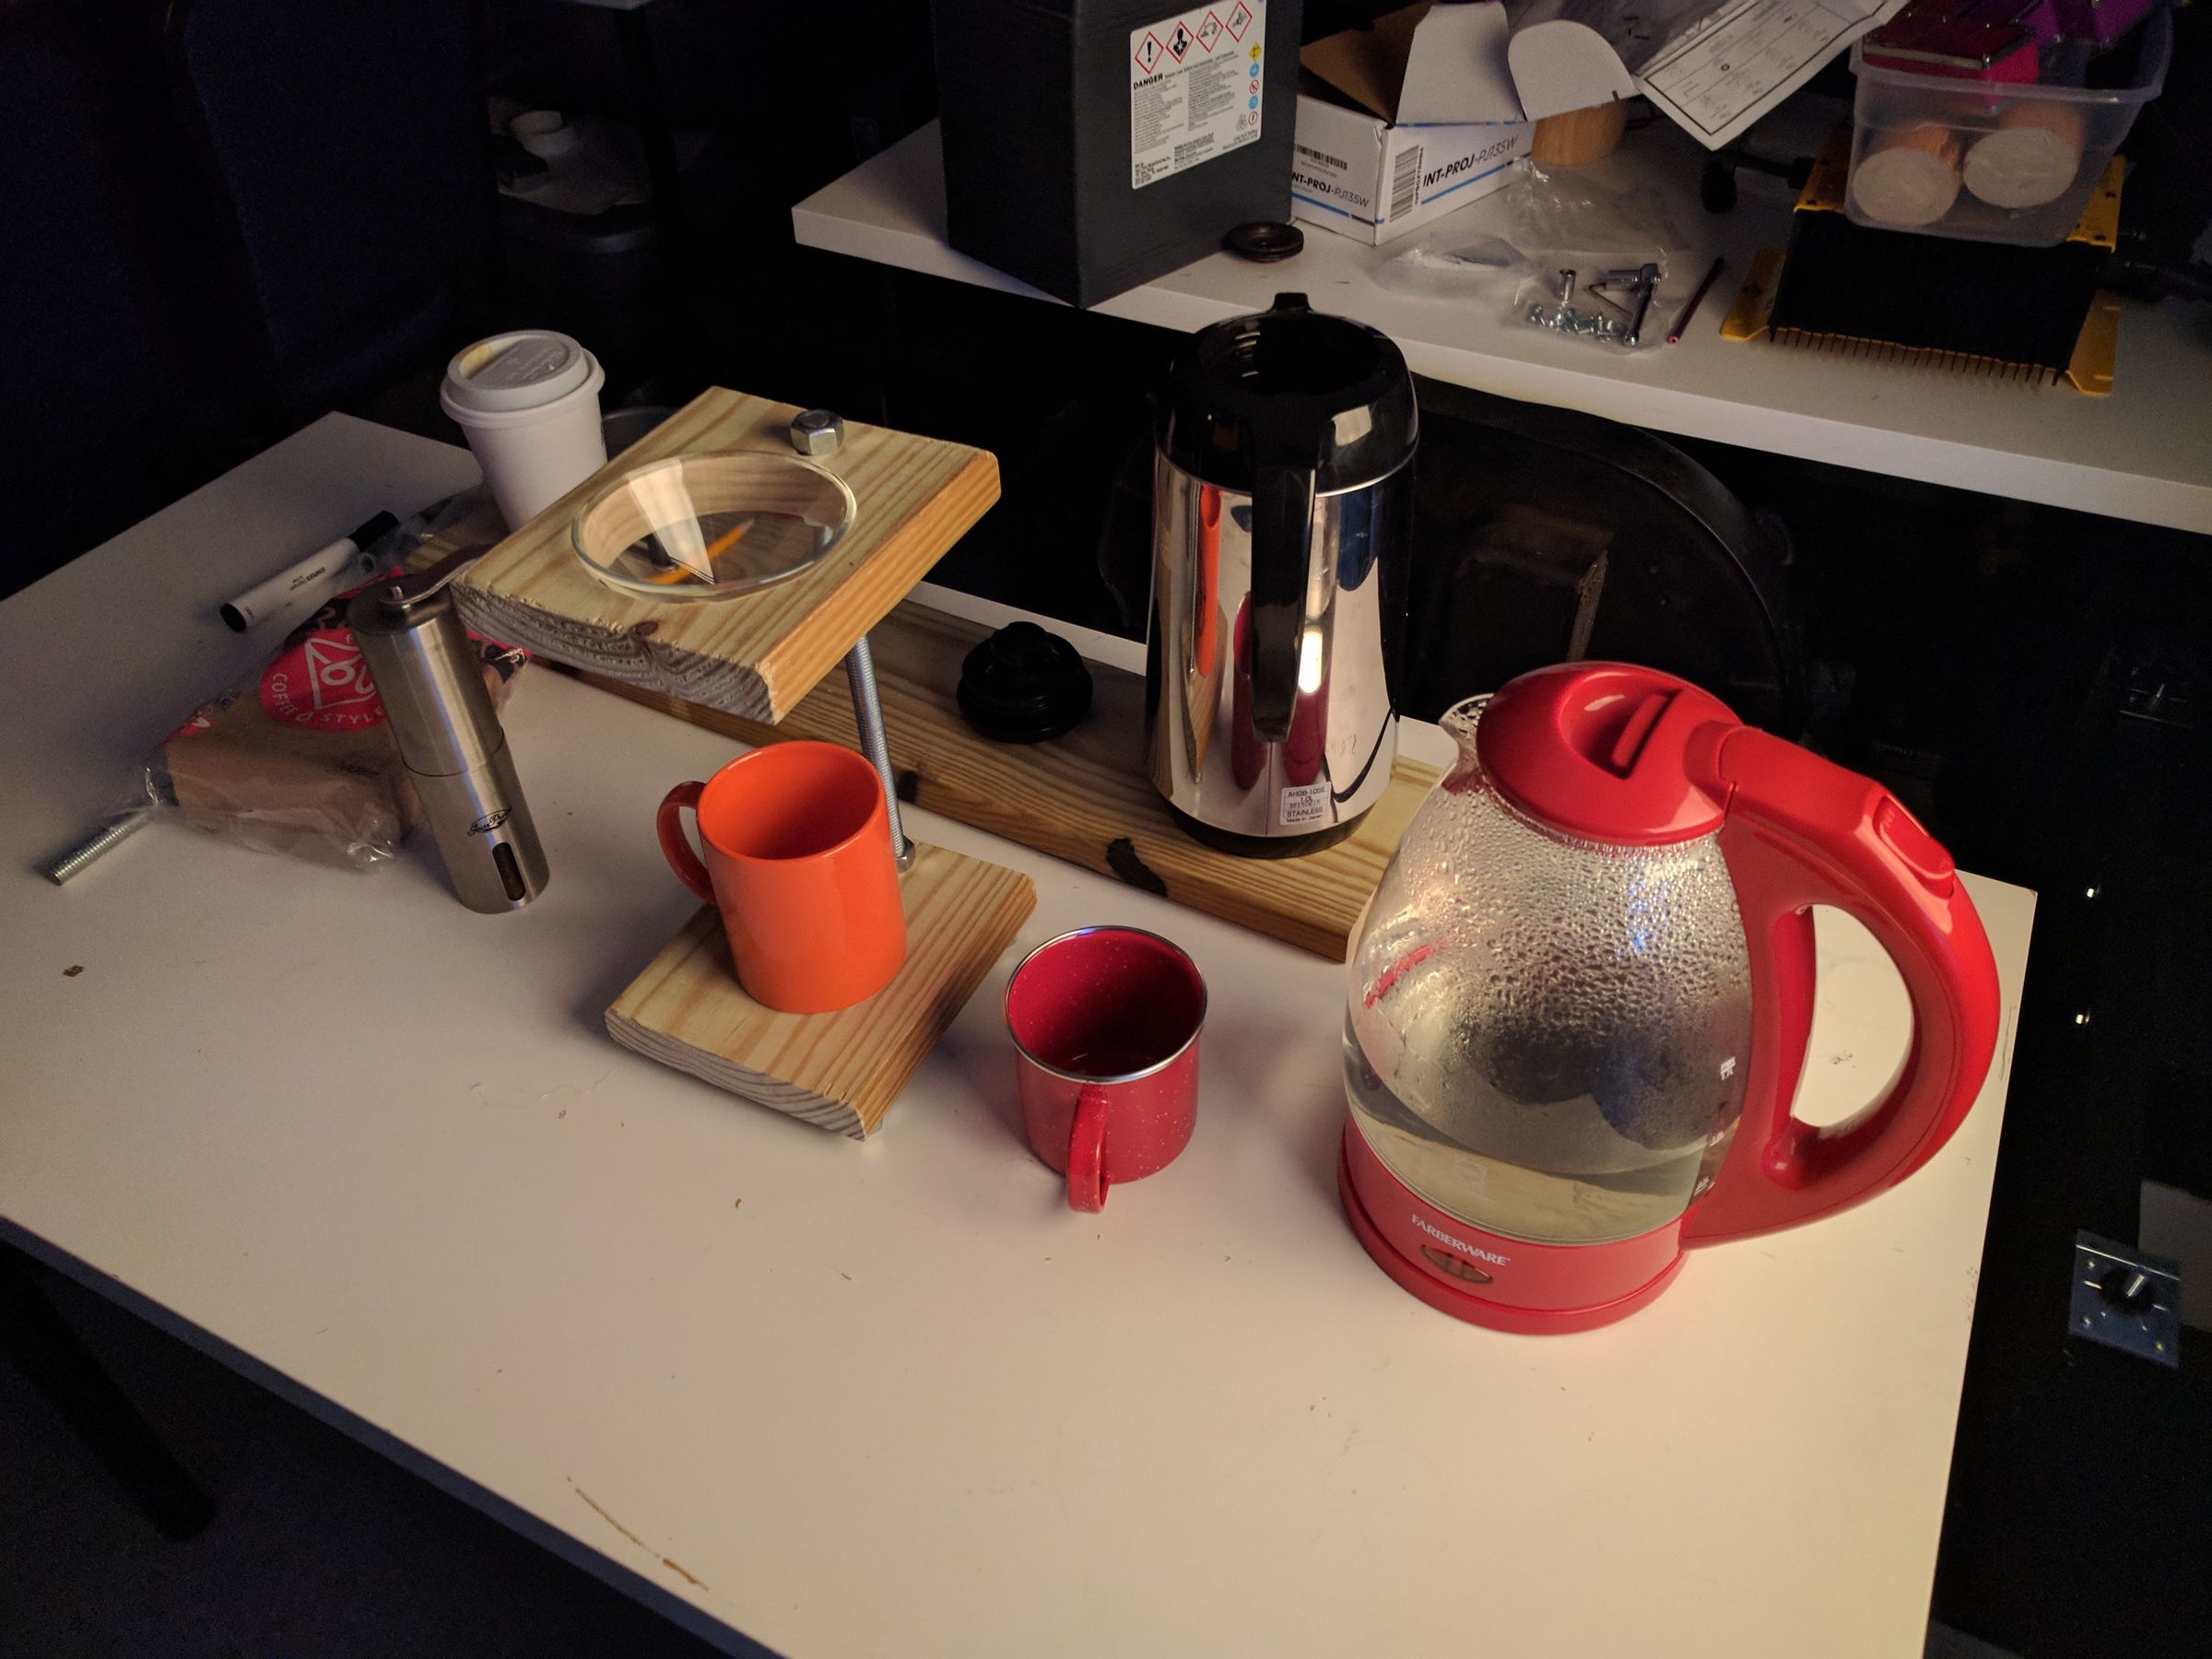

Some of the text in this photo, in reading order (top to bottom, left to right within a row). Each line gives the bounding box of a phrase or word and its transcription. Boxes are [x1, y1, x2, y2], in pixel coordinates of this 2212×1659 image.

[1133, 73, 1163, 90] DANGER
[1291, 171, 1371, 207] NT-PROJ-PJ135W
[271, 673, 299, 716] COFFEE
[1287, 807, 1324, 818] STAINLESS
[1411, 1214, 1508, 1266] FARBERWARE
